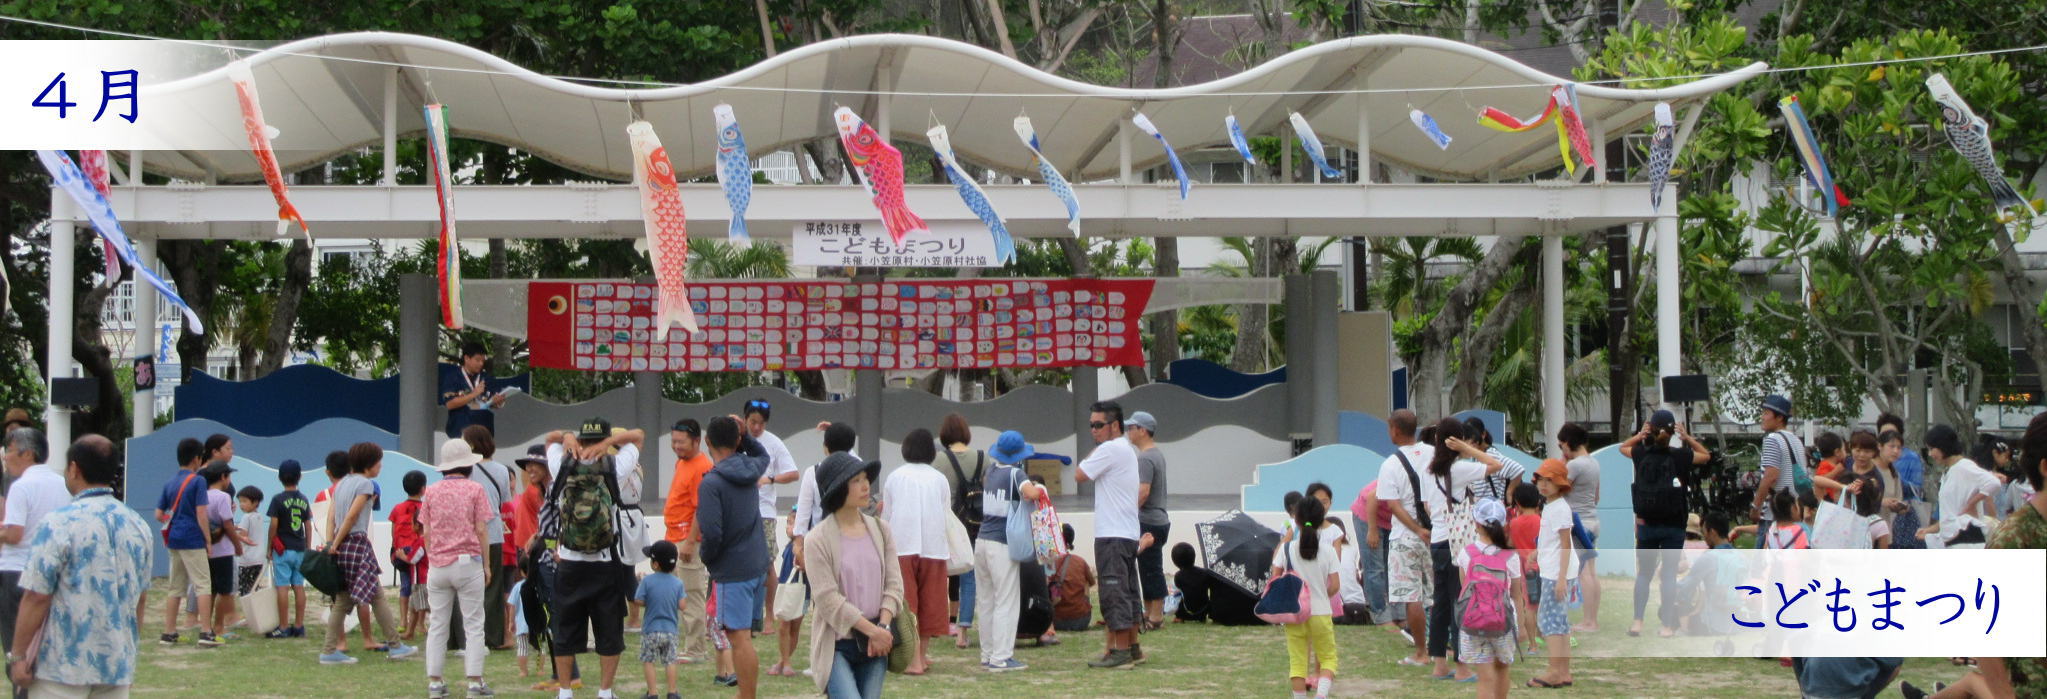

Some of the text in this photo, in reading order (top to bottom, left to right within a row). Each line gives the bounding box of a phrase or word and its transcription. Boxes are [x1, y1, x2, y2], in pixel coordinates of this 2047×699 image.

[806, 222, 863, 236] 平成31年度
[291, 508, 302, 531] 5
